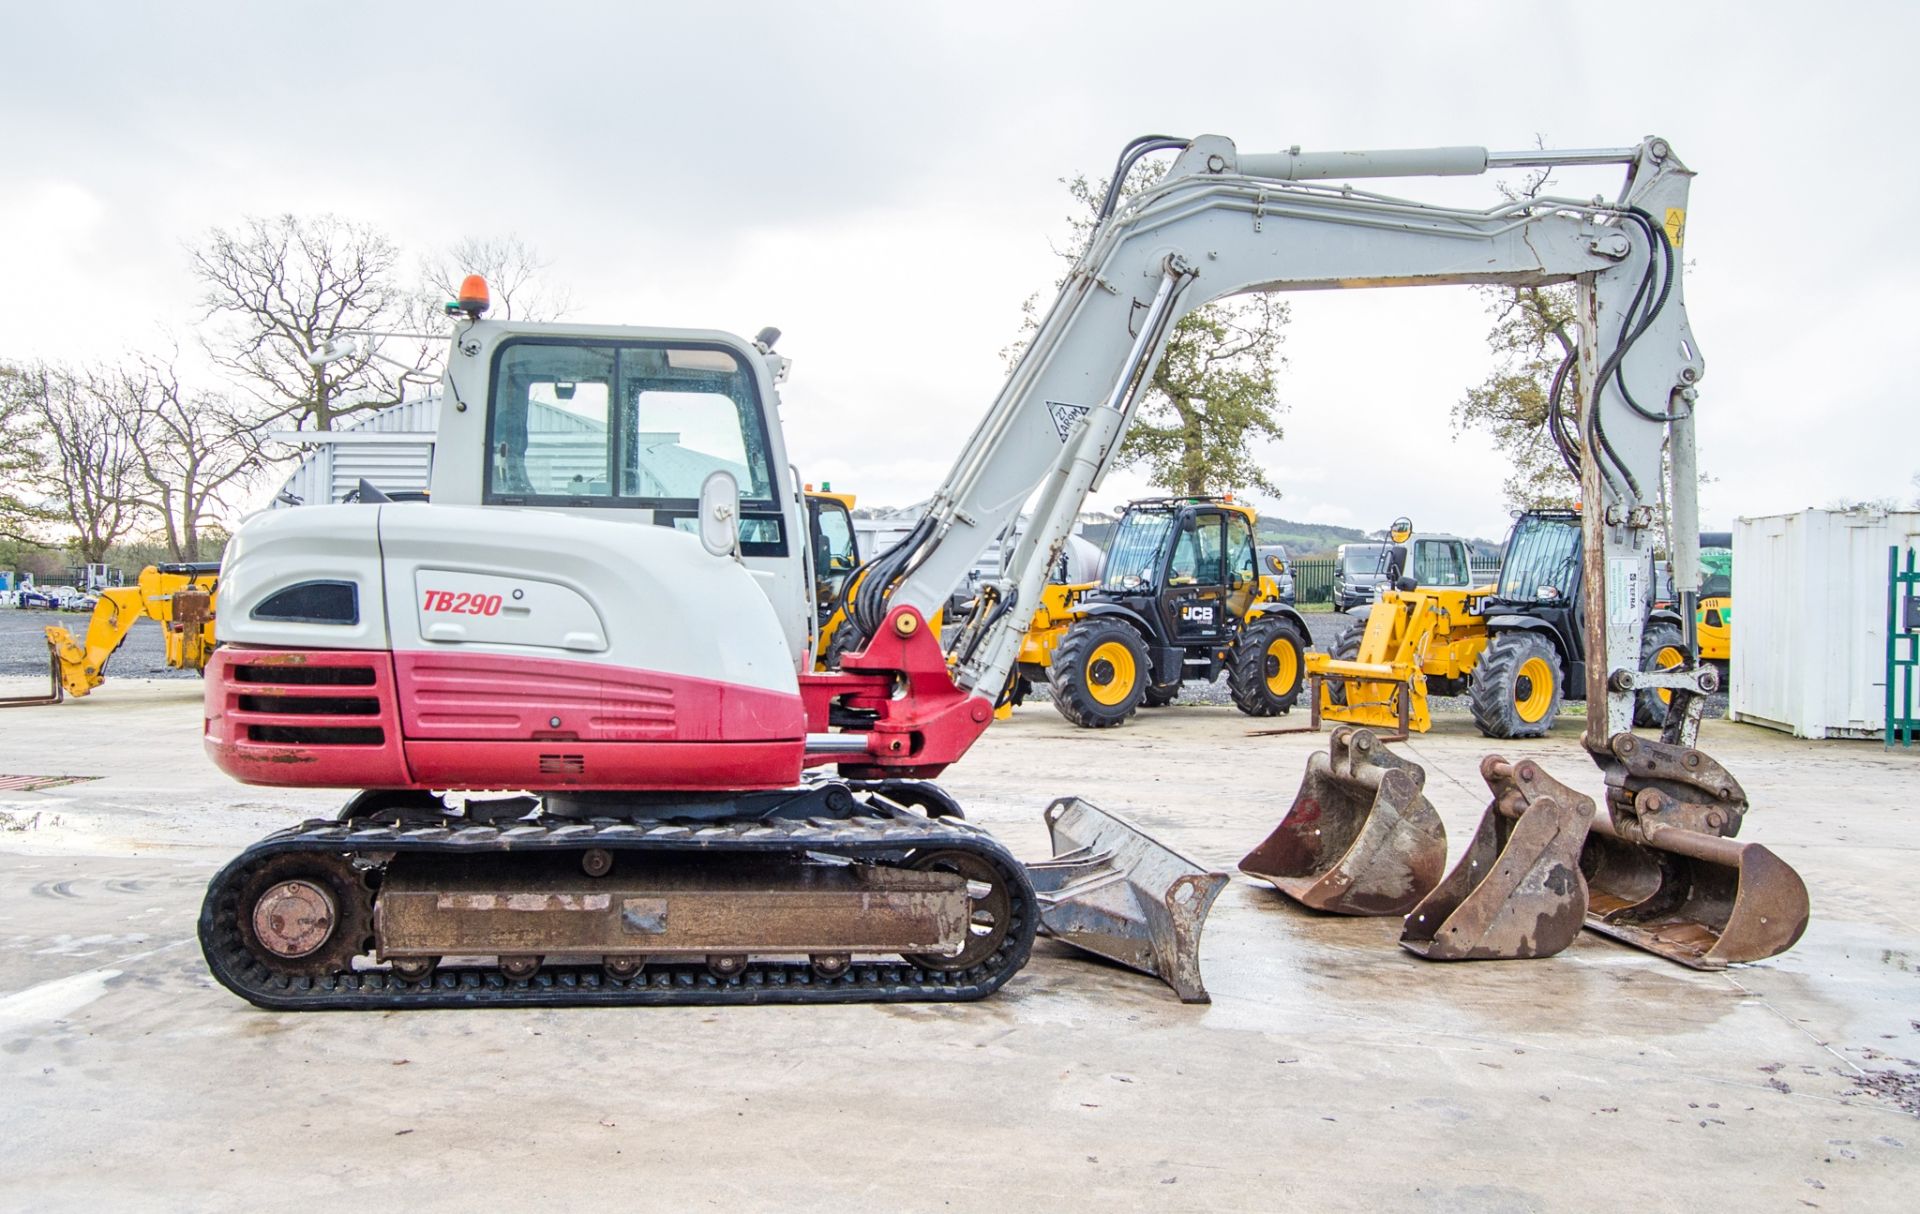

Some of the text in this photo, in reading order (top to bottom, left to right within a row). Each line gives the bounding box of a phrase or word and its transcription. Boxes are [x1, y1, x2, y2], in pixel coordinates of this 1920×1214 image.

[1055, 407, 1067, 421] 27
[423, 590, 503, 616] TB290
[1470, 596, 1494, 615] JC
[1182, 607, 1213, 620] JCB
